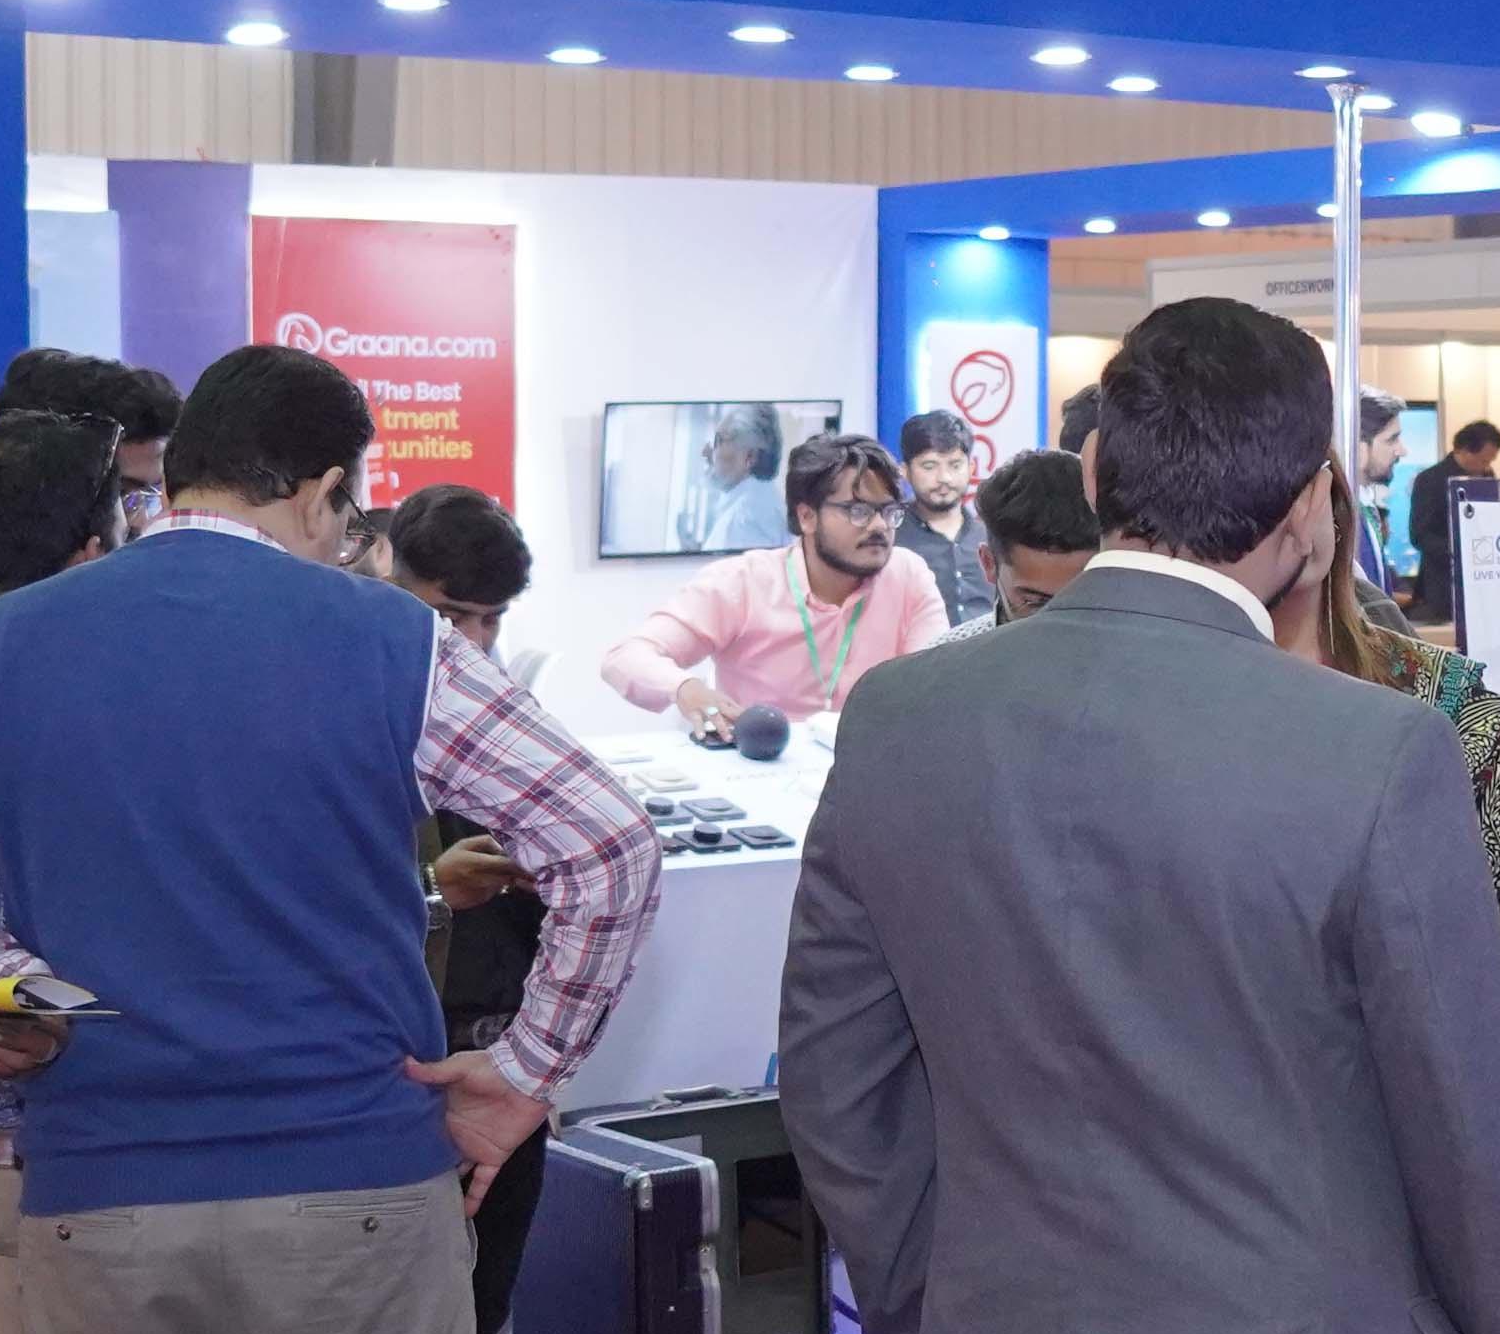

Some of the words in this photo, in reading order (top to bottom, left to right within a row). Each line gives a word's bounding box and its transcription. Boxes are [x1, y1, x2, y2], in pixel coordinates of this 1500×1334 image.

[324, 326, 497, 359] Graana.com
[373, 379, 412, 401] The
[415, 380, 462, 402] Best
[388, 434, 474, 460] unities
[1473, 569, 1494, 580] LIVE
